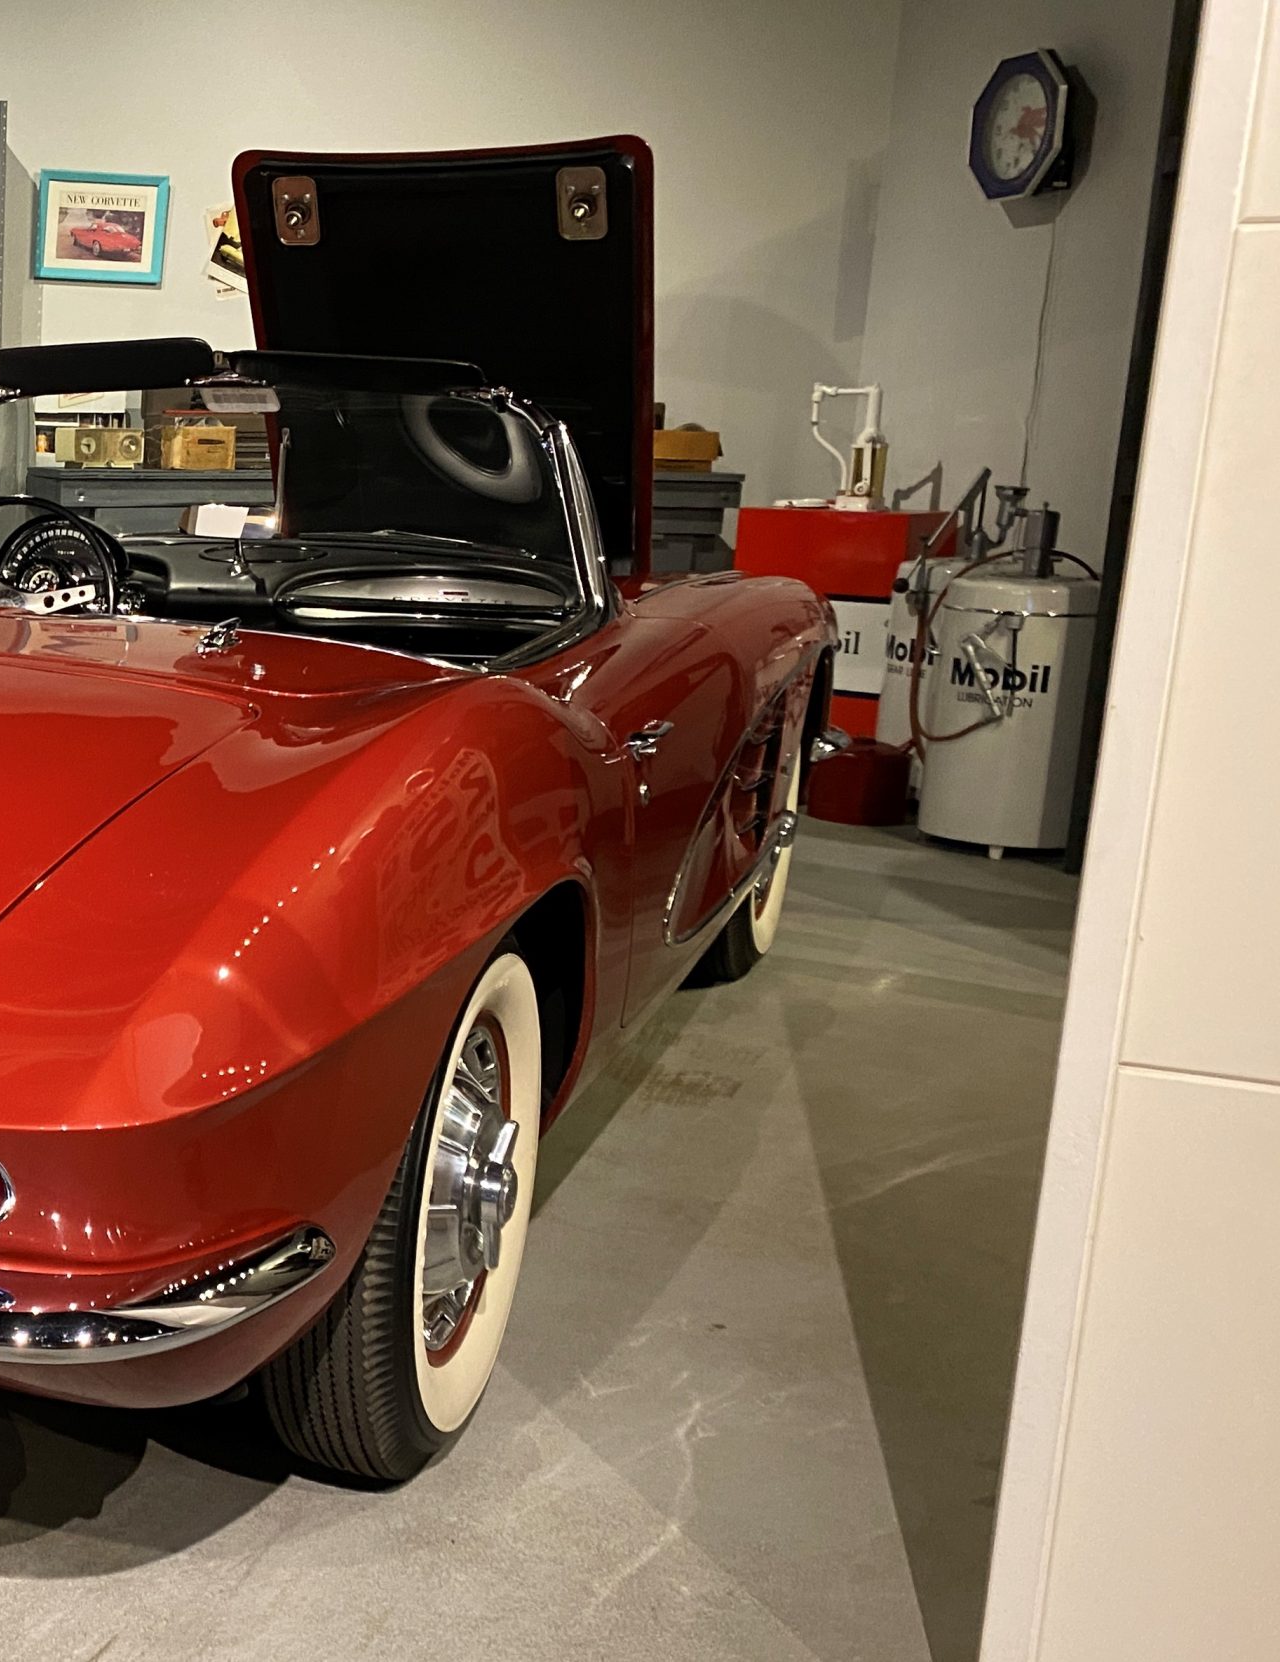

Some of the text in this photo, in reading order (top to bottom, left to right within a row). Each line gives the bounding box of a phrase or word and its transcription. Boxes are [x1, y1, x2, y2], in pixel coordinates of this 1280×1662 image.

[67, 194, 141, 207] NEW CORVETTE
[950, 657, 1051, 693] Mobil
